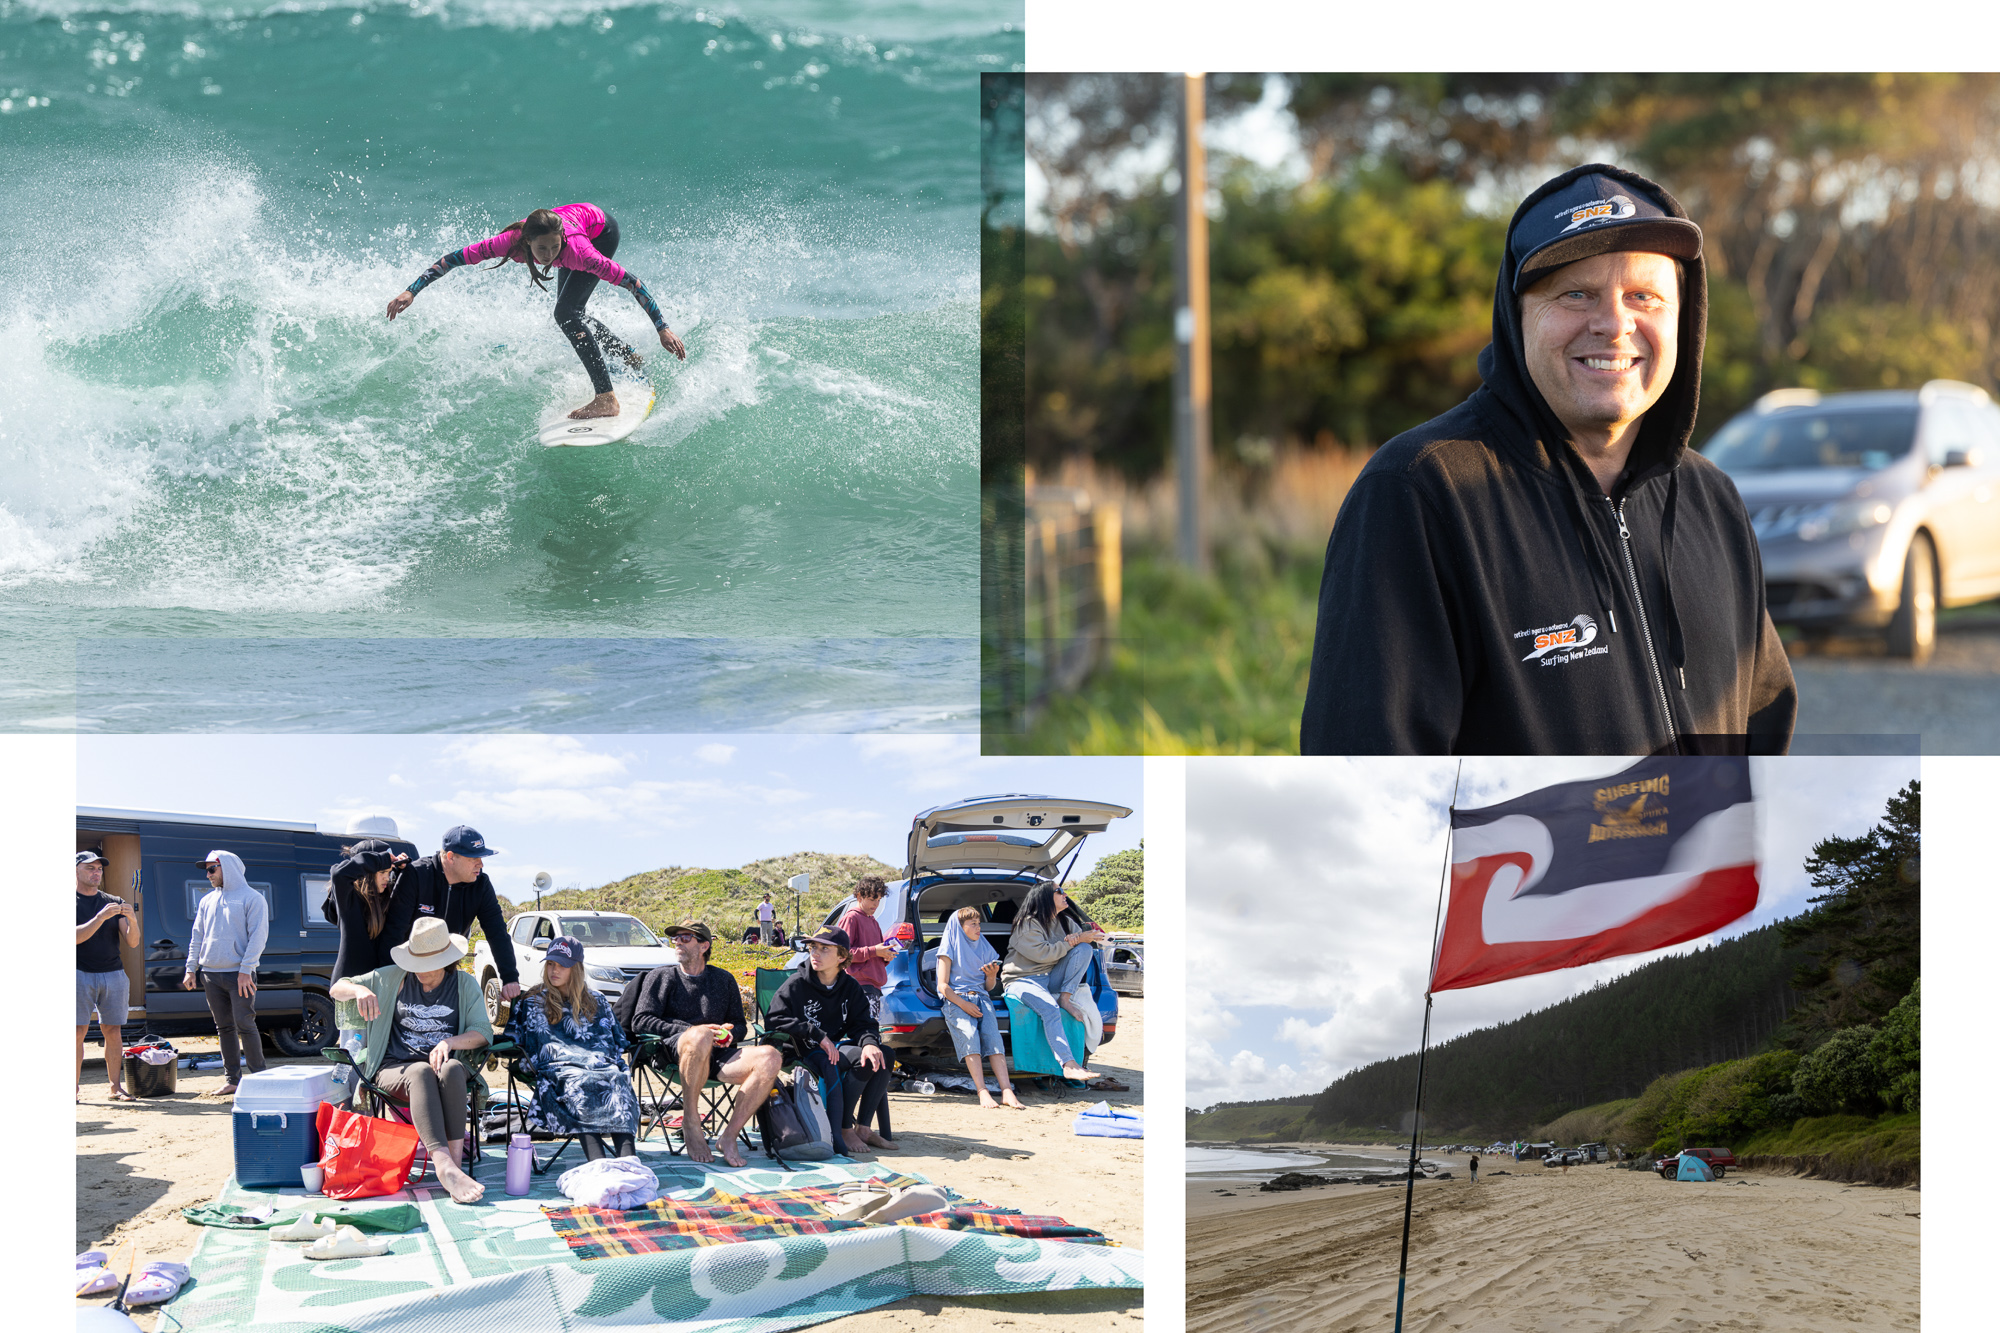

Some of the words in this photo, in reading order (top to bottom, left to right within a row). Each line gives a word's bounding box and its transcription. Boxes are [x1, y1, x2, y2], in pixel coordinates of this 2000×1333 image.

[1571, 204, 1612, 222] SNZ
[1534, 629, 1576, 650] SNZ
[1541, 654, 1569, 667] Surfing
[1570, 651, 1584, 661] New
[1584, 645, 1608, 657] Zealand
[1593, 774, 1669, 801] SURFING
